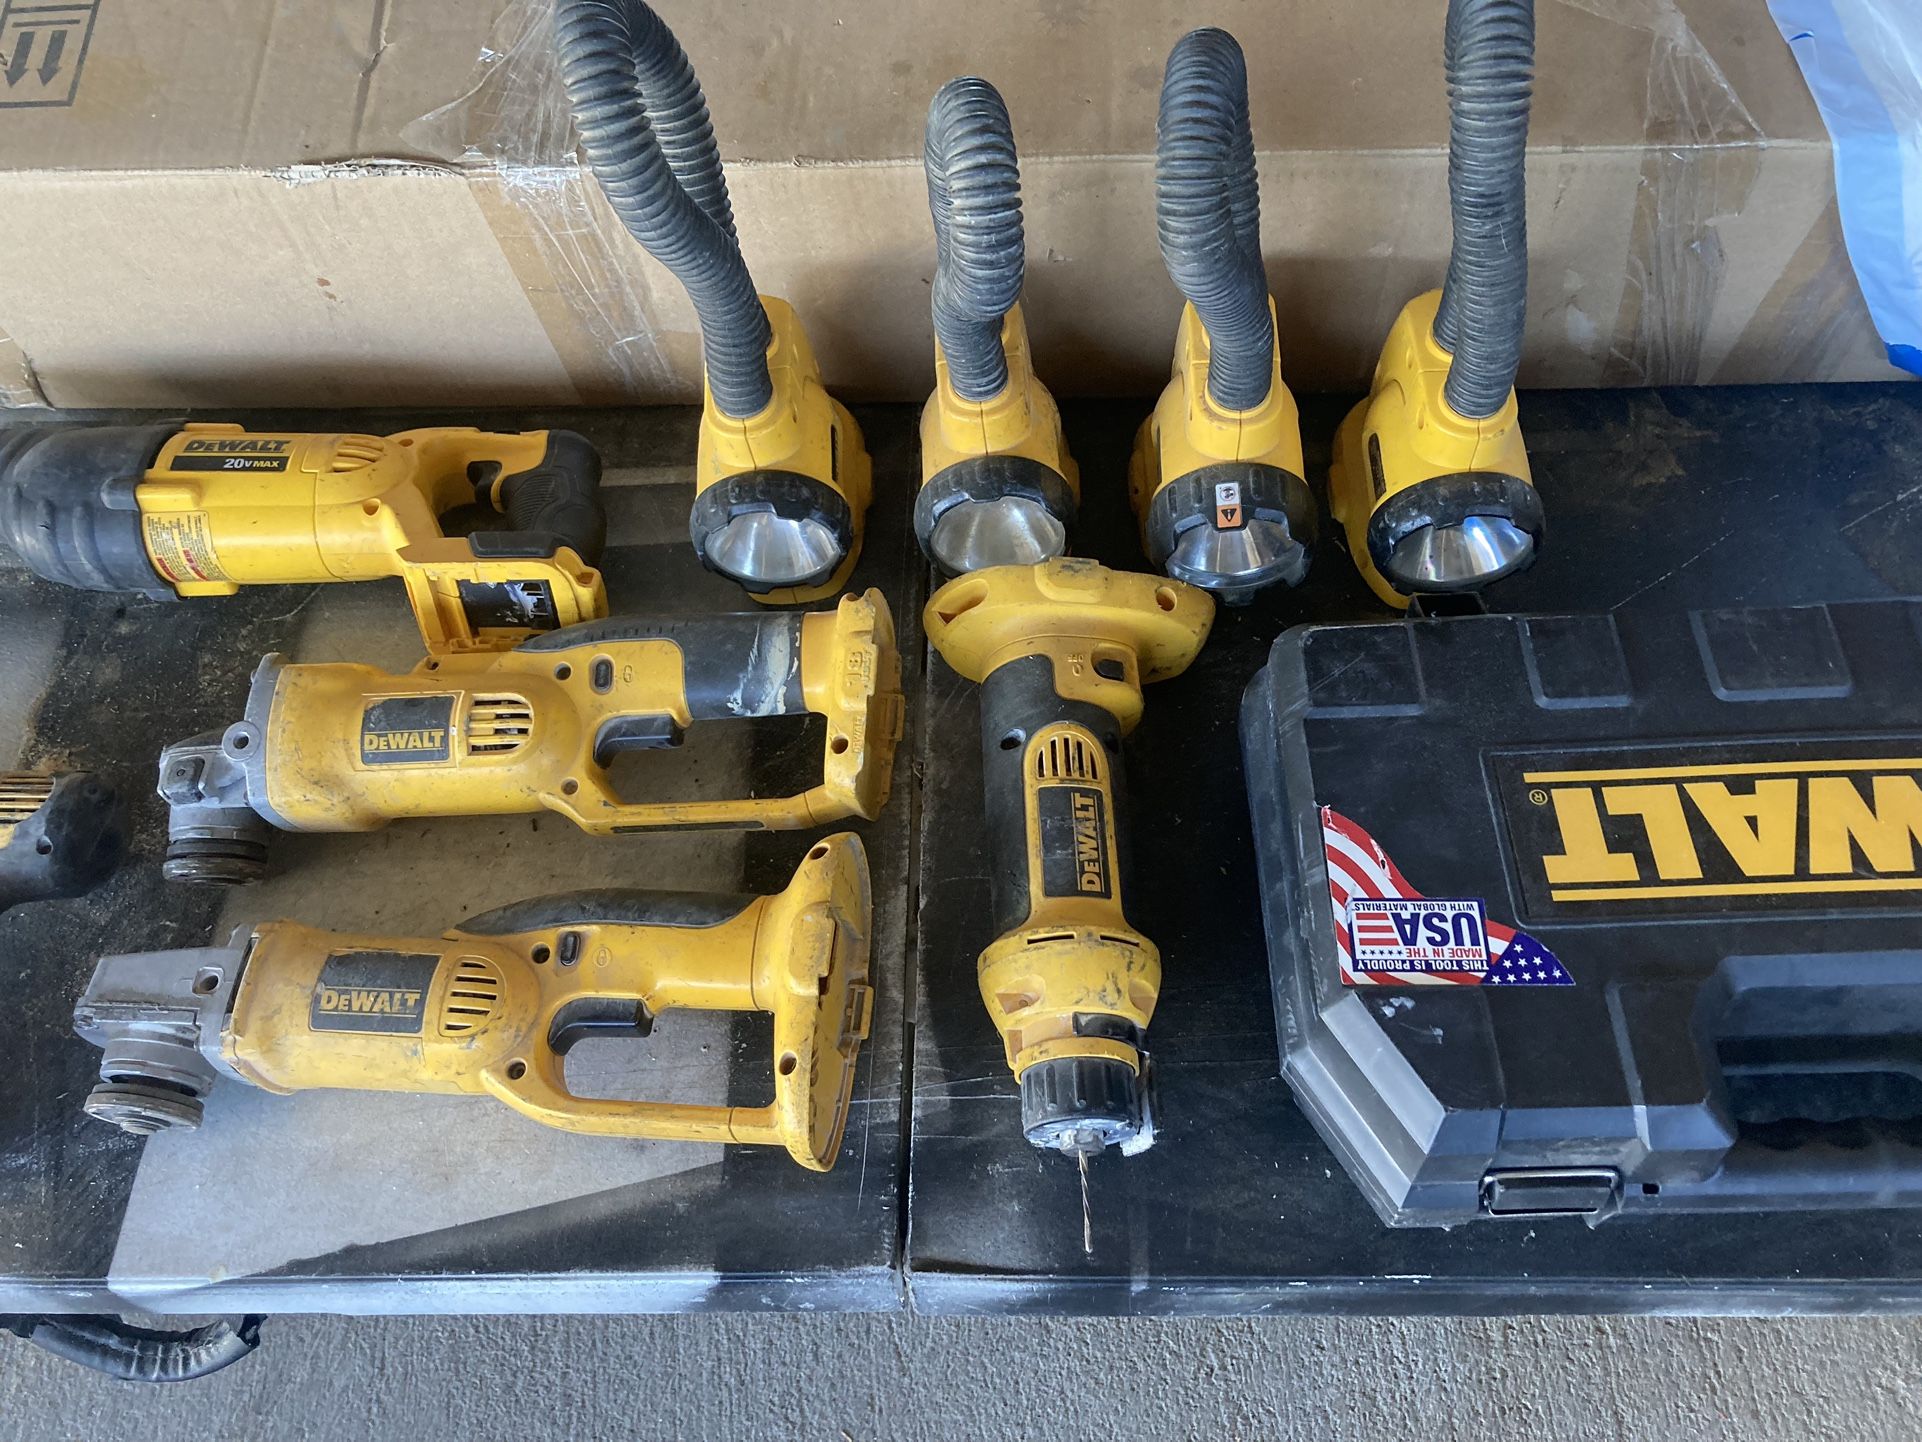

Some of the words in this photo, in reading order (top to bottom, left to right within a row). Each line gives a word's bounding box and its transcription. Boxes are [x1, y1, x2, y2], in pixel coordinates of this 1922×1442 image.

[363, 731, 445, 751] DEWALT
[1075, 792, 1102, 892] DEWALT
[1355, 902, 1408, 911] MATERIALS
[1410, 903, 1447, 911] GLOBAL
[1451, 903, 1475, 911] WITH
[1390, 912, 1482, 947] USA
[1406, 947, 1429, 958] THE
[1432, 947, 1445, 958] IN
[1447, 947, 1483, 959] MADE
[1357, 959, 1411, 970] PROUDLY
[1414, 960, 1426, 970] IS
[1428, 960, 1460, 970] TOOL
[1464, 960, 1490, 971] THIS
[318, 989, 422, 1014] DEWALT
